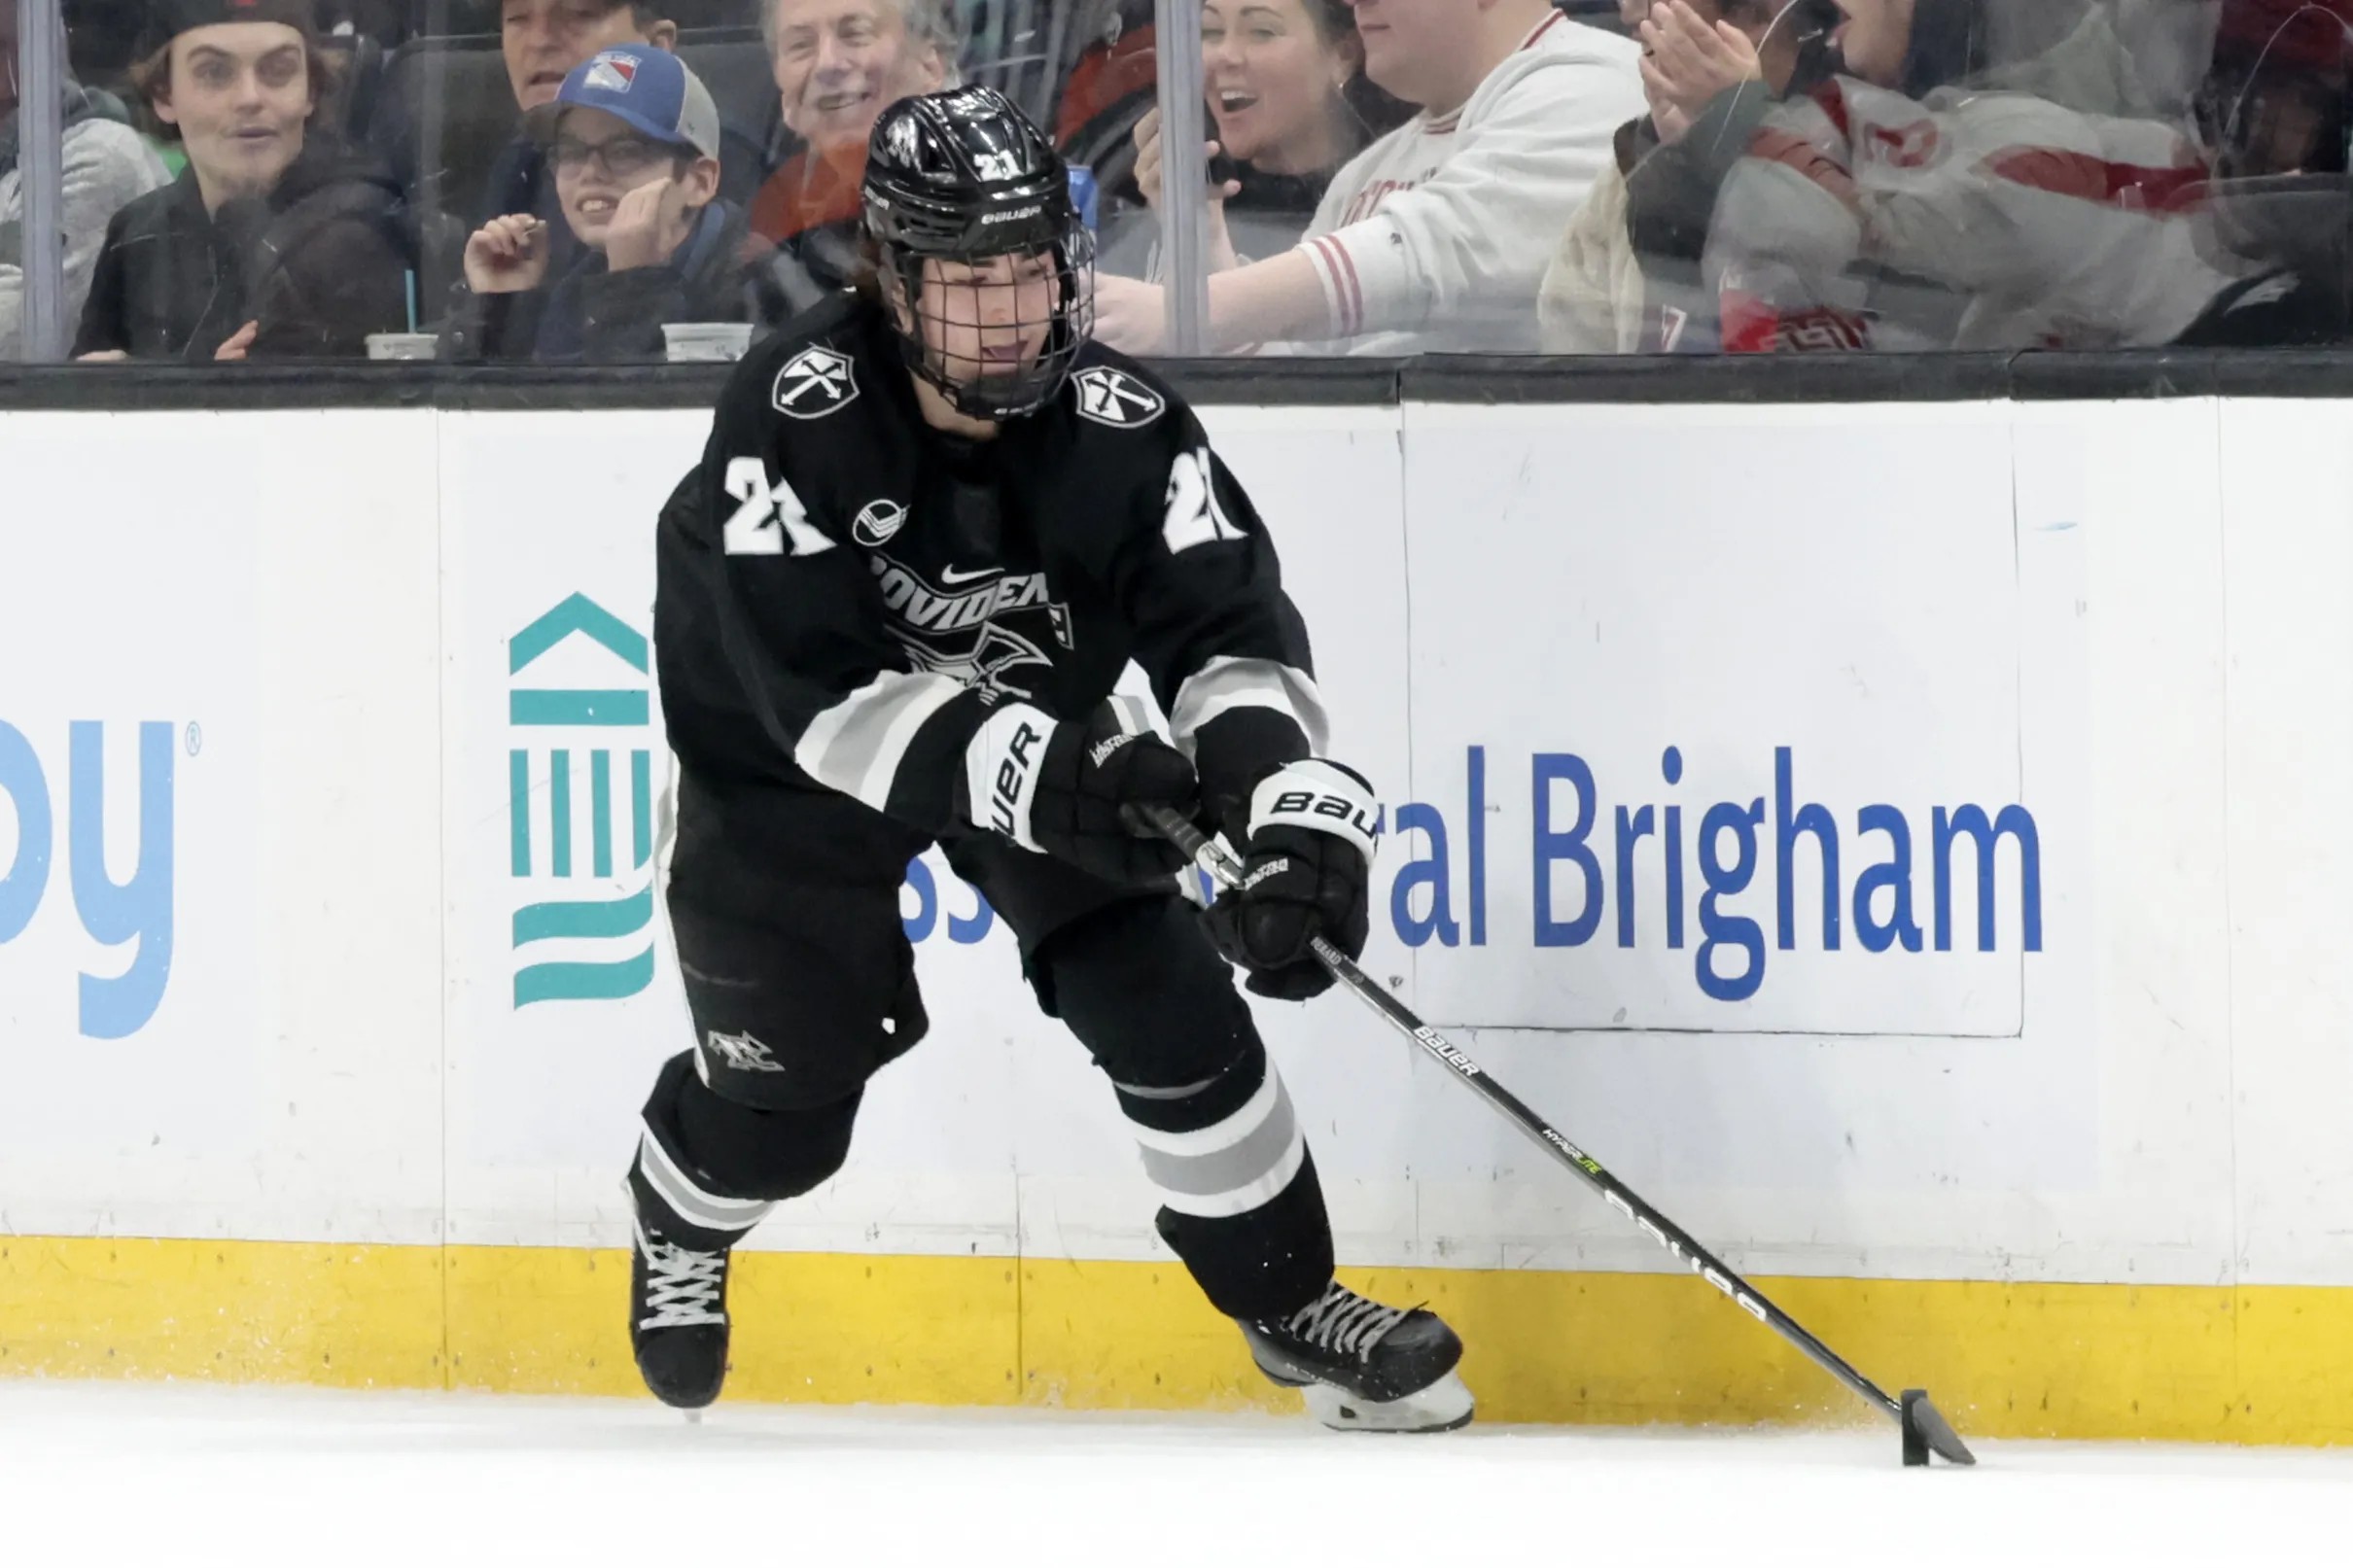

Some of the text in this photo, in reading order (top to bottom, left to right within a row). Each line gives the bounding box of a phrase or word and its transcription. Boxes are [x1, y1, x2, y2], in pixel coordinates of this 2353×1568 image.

[973, 149, 1022, 182] 21
[722, 456, 837, 556] 21
[1162, 446, 1248, 555] 21
[1270, 791, 1378, 844] BAU
[1531, 745, 2043, 1001] Brigham
[1414, 1026, 1479, 1076] BAUER
[1543, 1129, 1602, 1174] HYPERLITE
